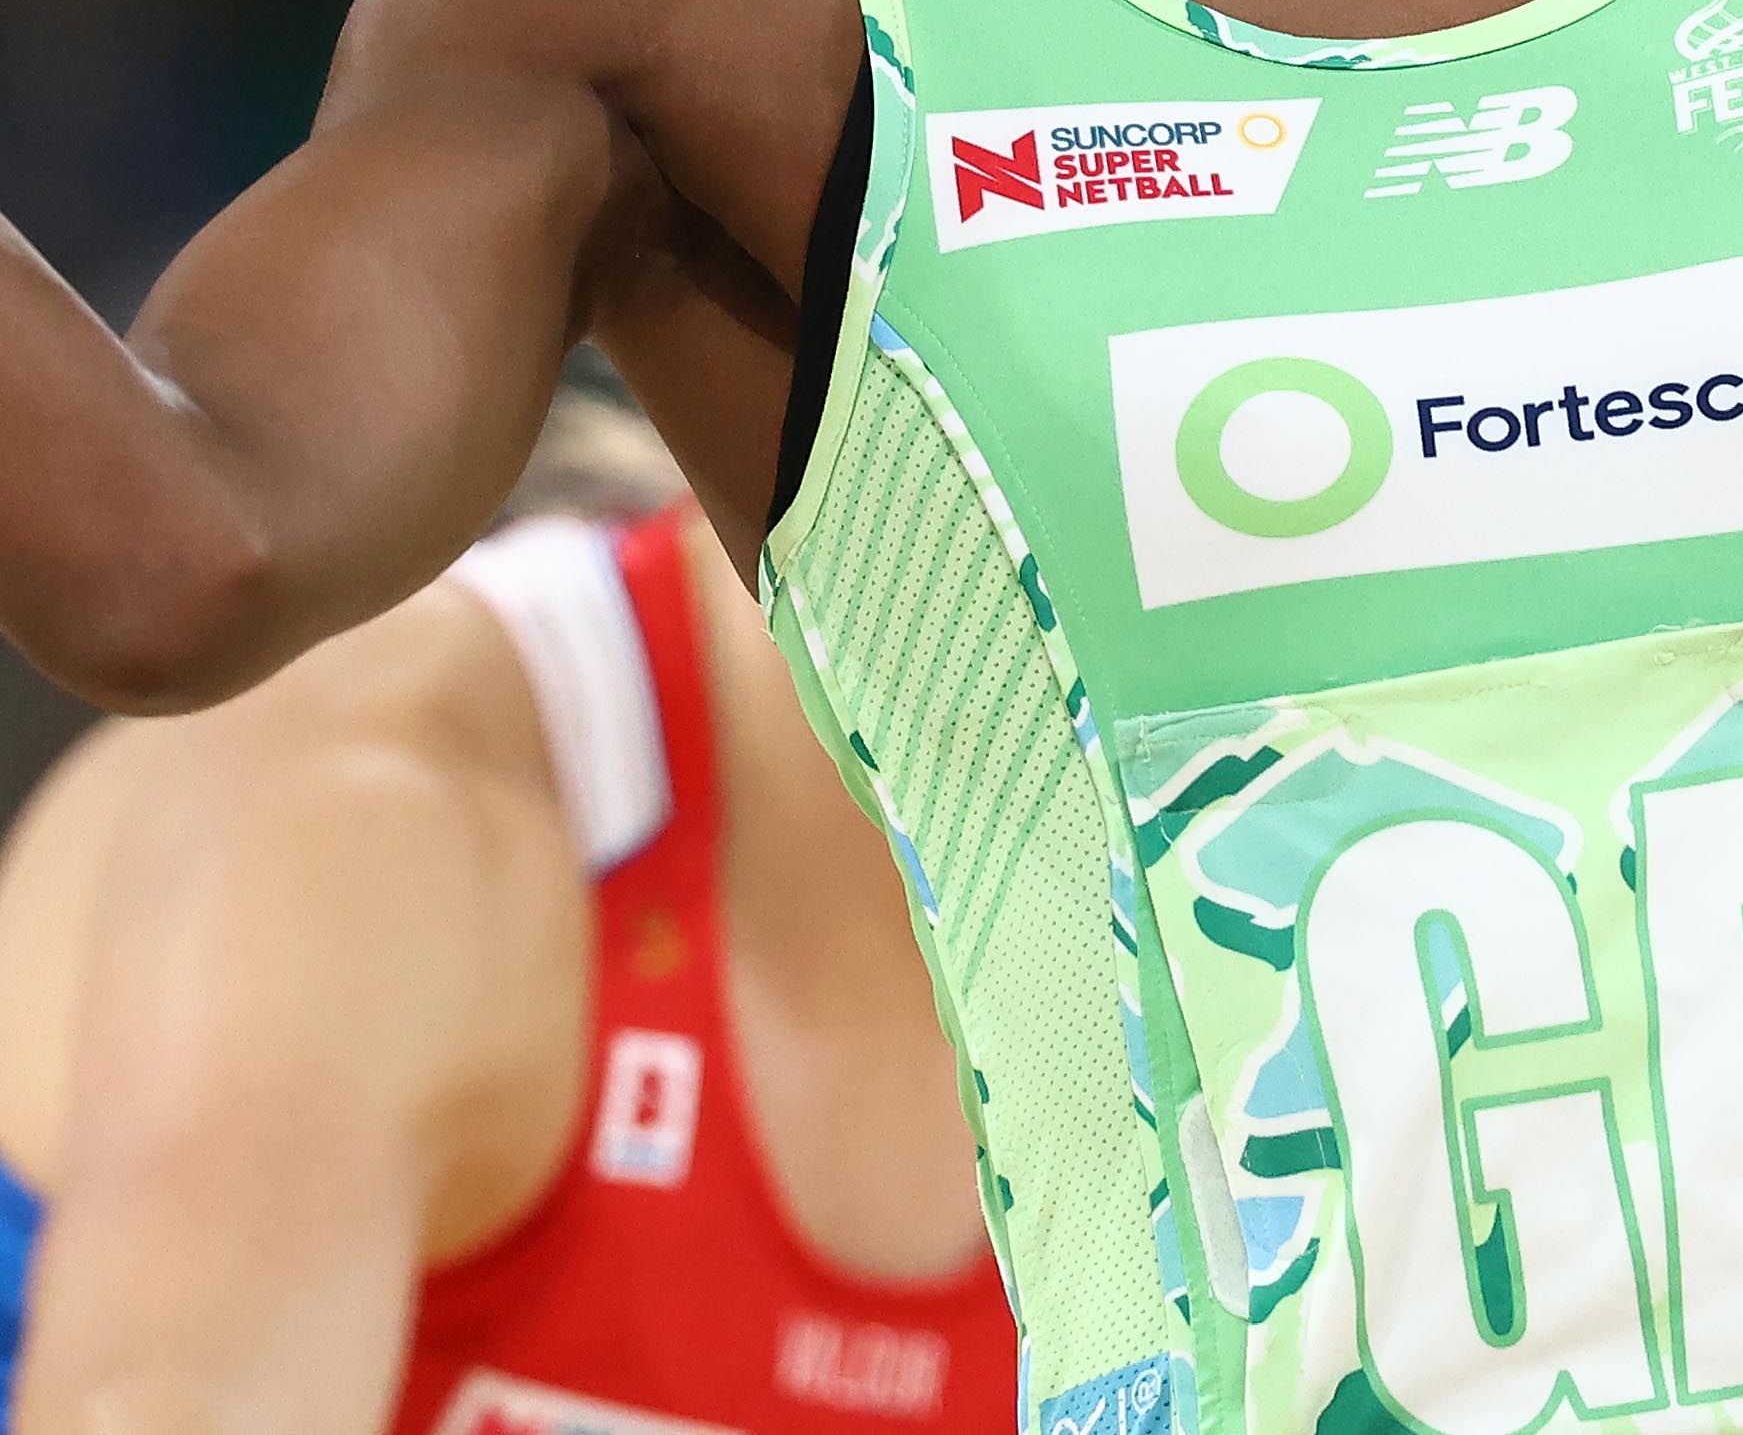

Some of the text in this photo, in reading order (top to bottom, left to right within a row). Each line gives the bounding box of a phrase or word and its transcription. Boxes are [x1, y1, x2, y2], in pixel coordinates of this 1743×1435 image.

[1667, 55, 1733, 84] WEST
[1050, 121, 1223, 152] SUNCORP
[1053, 149, 1182, 181] SUPER
[1055, 173, 1234, 209] NETBALL
